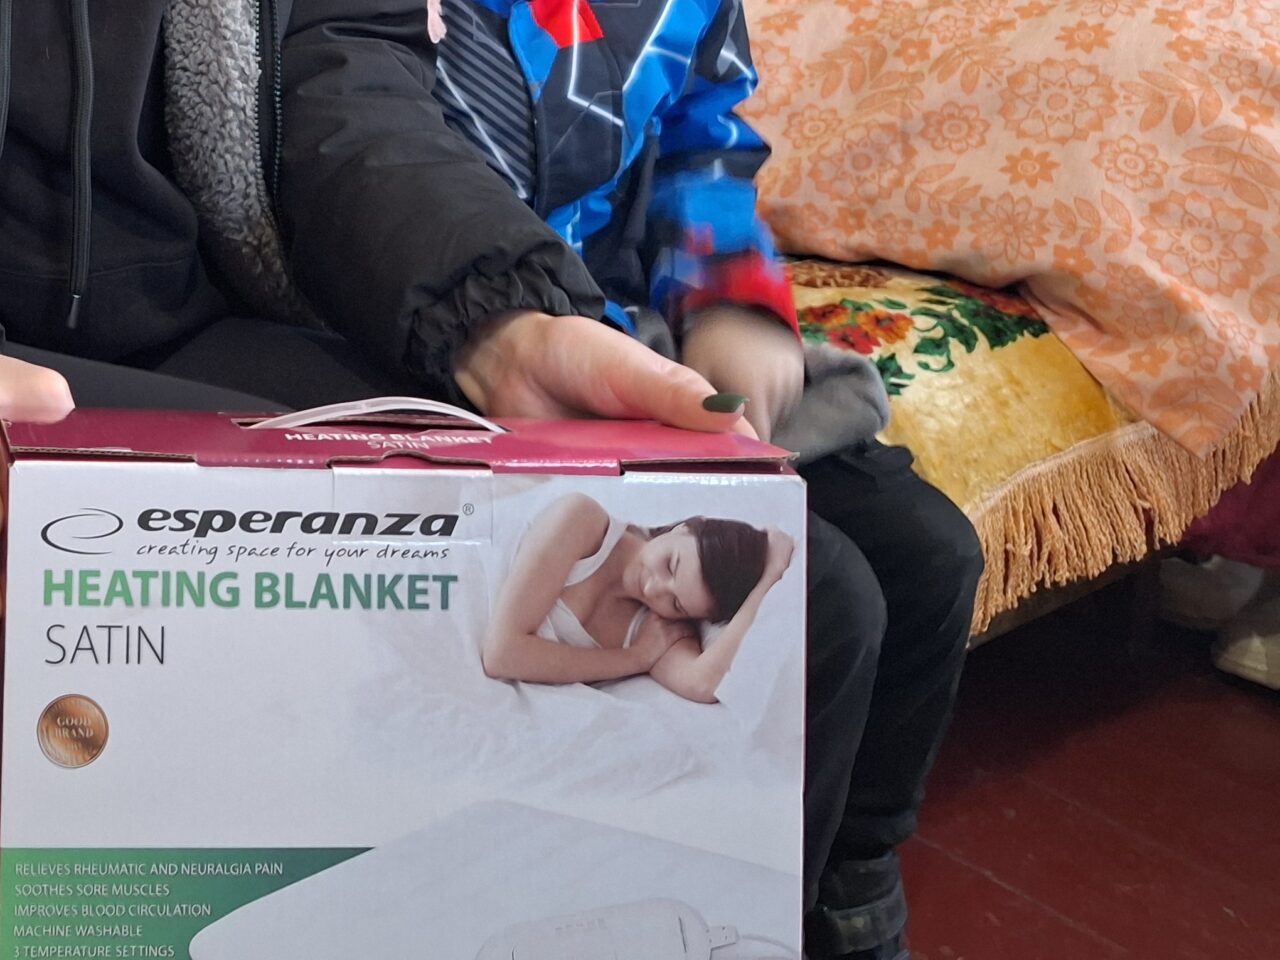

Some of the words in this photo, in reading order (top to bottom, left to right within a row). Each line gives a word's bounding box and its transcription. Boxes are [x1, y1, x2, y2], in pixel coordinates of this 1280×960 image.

[284, 433, 385, 441] HEATING
[390, 433, 492, 444] BLANKET
[367, 440, 430, 450] SATIN
[137, 539, 219, 565] creating
[227, 542, 281, 562] space
[286, 542, 315, 562] for
[324, 548, 368, 567] your
[376, 546, 450, 560] dreams
[43, 569, 241, 608] HEATING
[253, 572, 459, 611] BLANKET
[44, 624, 166, 666] SATIN
[15, 863, 71, 876] RELIEVES
[74, 863, 146, 876] RHEUMATIC
[150, 863, 178, 876] AND
[181, 863, 252, 876] NEURALGIA
[254, 863, 283, 876] PAIN
[14, 884, 72, 897] SOOTHES
[76, 884, 108, 897] SORE
[111, 884, 170, 897] MUSCLES
[14, 904, 78, 917] IMPROVES
[81, 904, 125, 917] BLOOD
[128, 904, 211, 917] CIRCULATION
[13, 925, 71, 938] MACHINE
[75, 925, 143, 938] WASHABLE
[14, 945, 21, 959] 3
[23, 945, 112, 959] TEMPERATURE
[115, 945, 175, 959] SETTINGS
